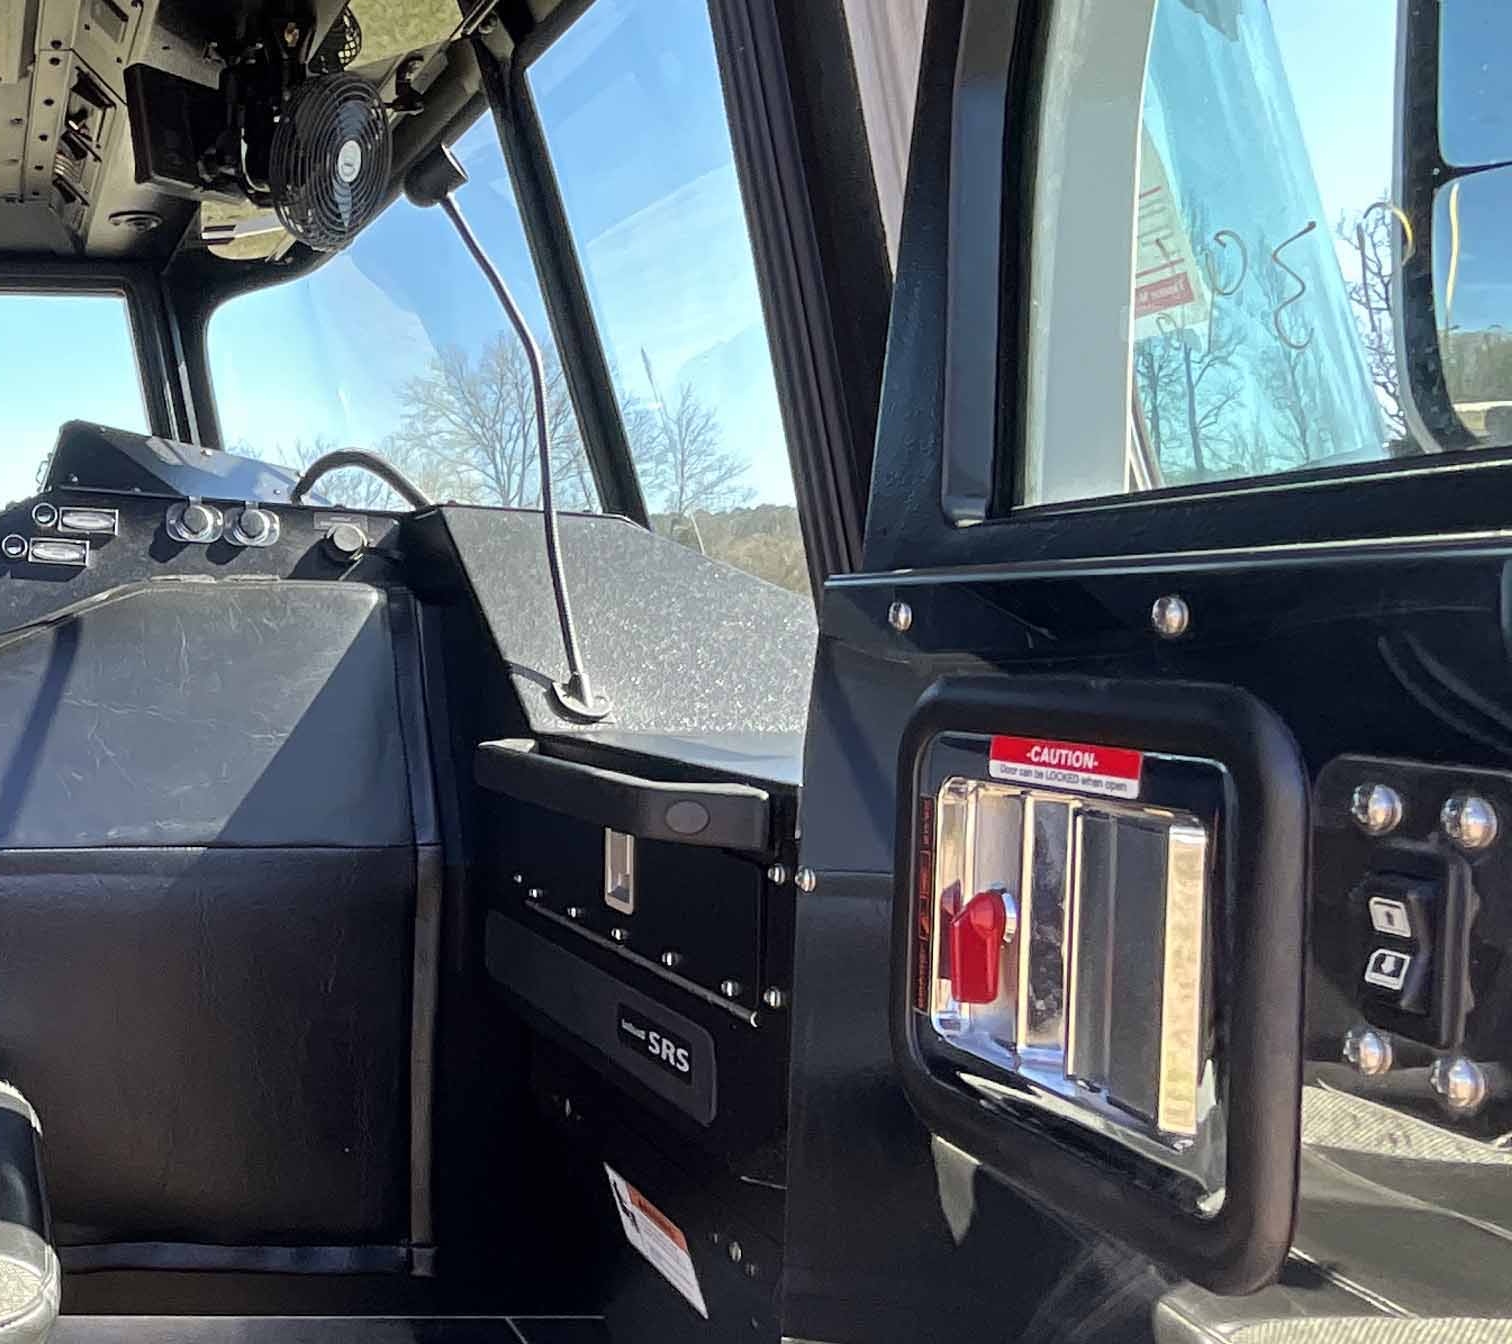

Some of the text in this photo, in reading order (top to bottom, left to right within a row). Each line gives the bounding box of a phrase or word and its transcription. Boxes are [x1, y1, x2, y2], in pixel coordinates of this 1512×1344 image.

[999, 762, 1128, 793] Door can be LOCKED when open
[648, 1031, 690, 1073] SRS
